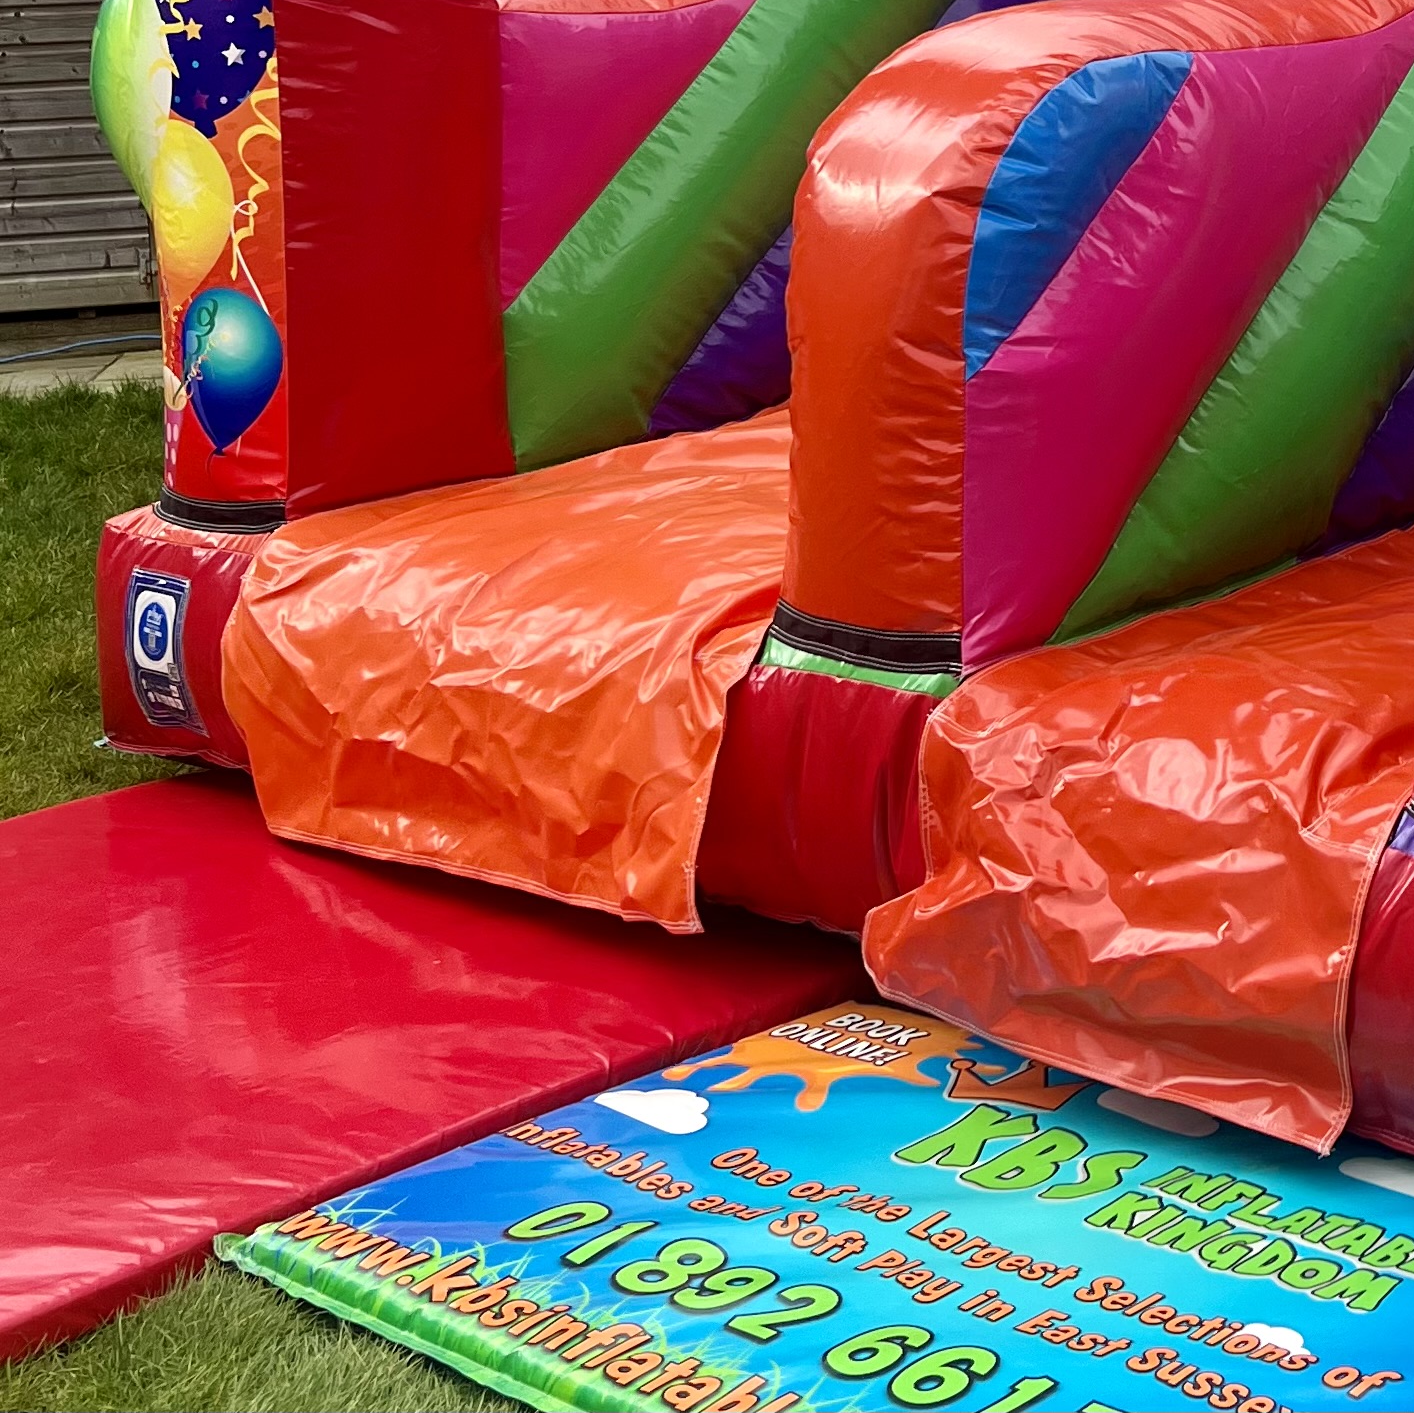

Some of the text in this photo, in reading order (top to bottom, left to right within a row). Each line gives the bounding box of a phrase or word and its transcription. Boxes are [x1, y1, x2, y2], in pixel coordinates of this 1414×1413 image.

[769, 1022, 912, 1066] ONLINE!
[822, 1013, 931, 1046] BOOK
[897, 1103, 1148, 1199] KBS
[498, 1118, 1296, 1413] nflatables and Soft Play in East Susse
[504, 1200, 1125, 1413] 01892 661
[711, 1147, 1403, 1399] One of the Largest Selections of
[1084, 1192, 1404, 1312] KINGDOM
